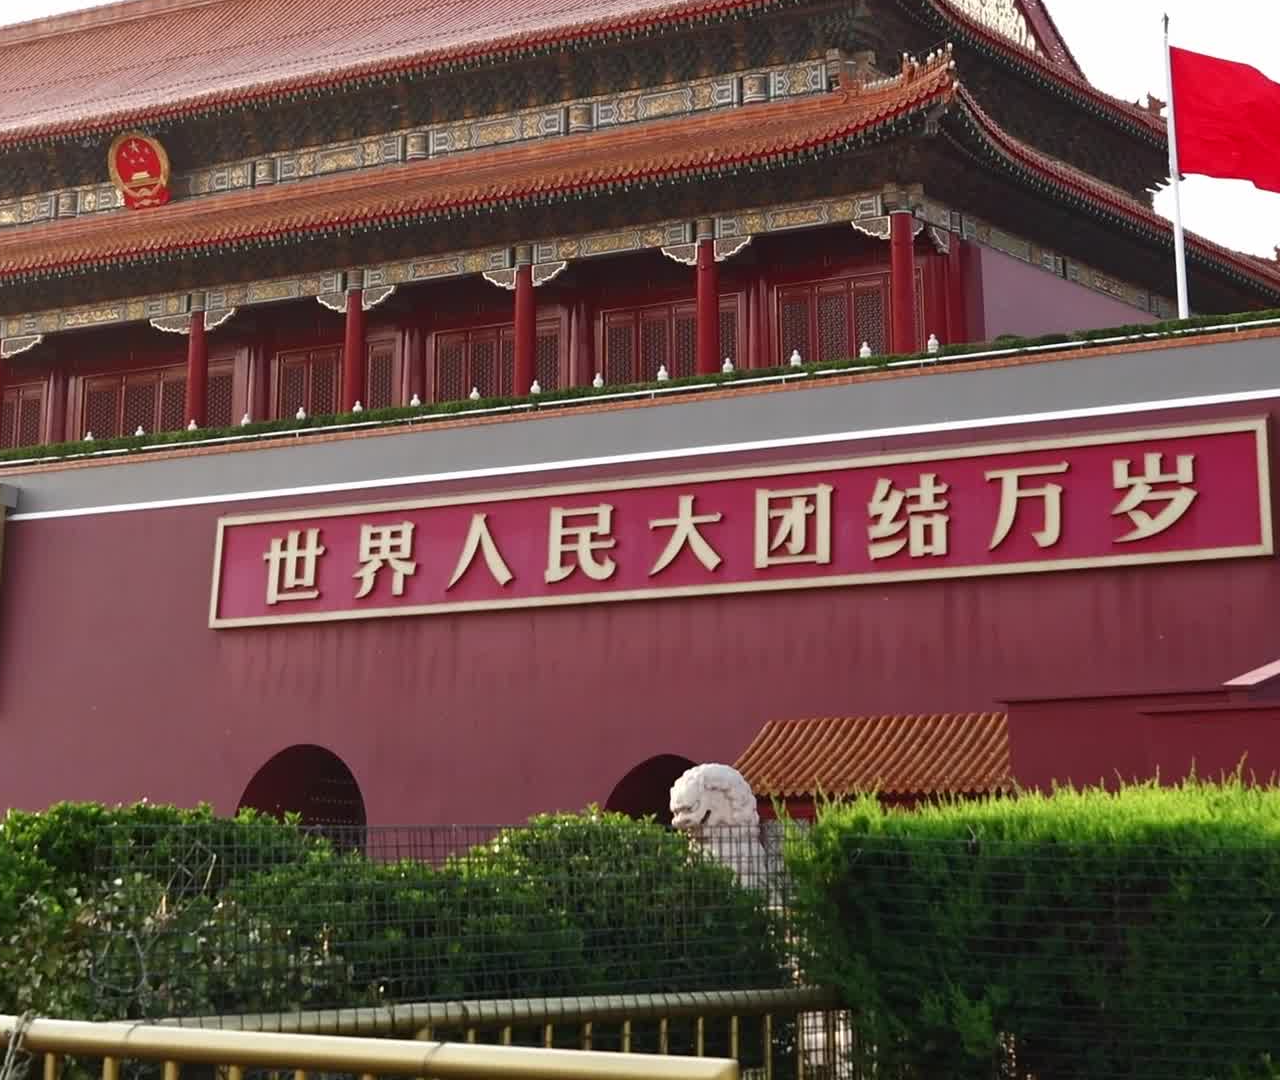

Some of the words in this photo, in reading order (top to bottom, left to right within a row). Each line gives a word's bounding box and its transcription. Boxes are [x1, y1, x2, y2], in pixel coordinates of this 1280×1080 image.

[263, 452, 1199, 606] 世界人民大团结万岁
